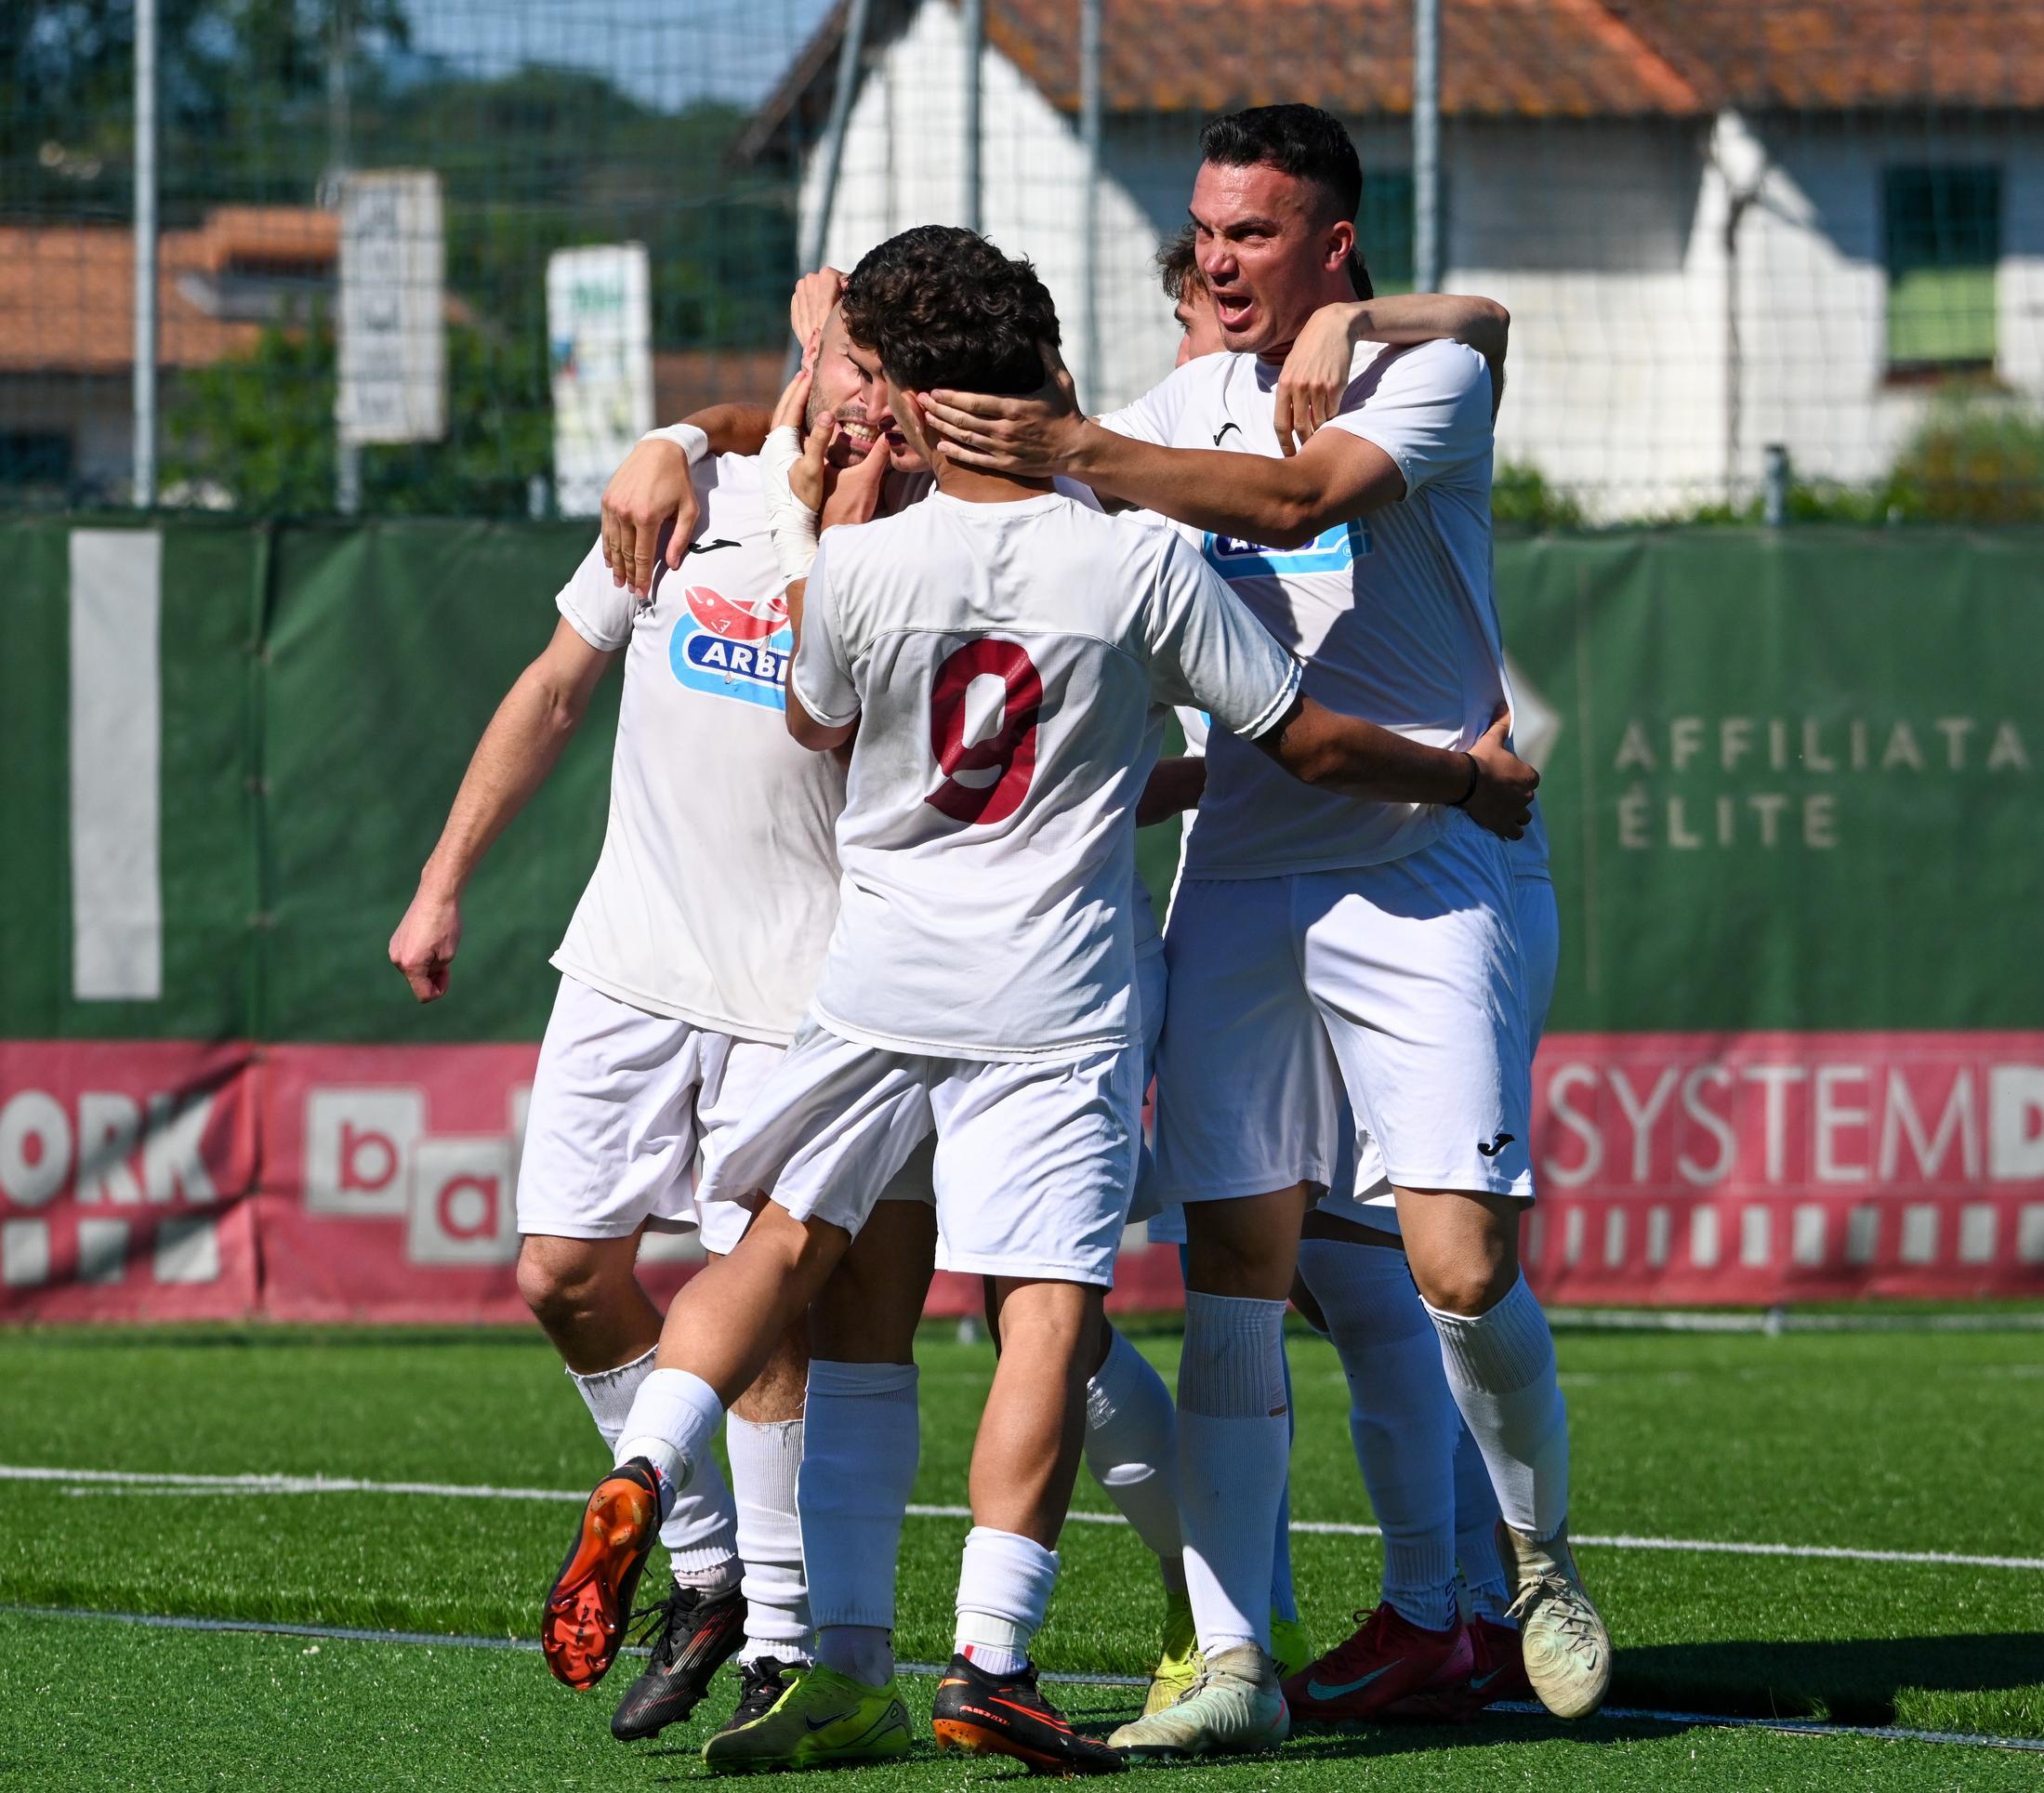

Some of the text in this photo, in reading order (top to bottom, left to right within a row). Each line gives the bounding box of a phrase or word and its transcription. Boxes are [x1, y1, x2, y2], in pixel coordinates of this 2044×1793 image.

[924, 639, 1043, 824] 9
[1615, 718, 2028, 771] AFFILIATA
[1616, 783, 1837, 849] ÉLITE
